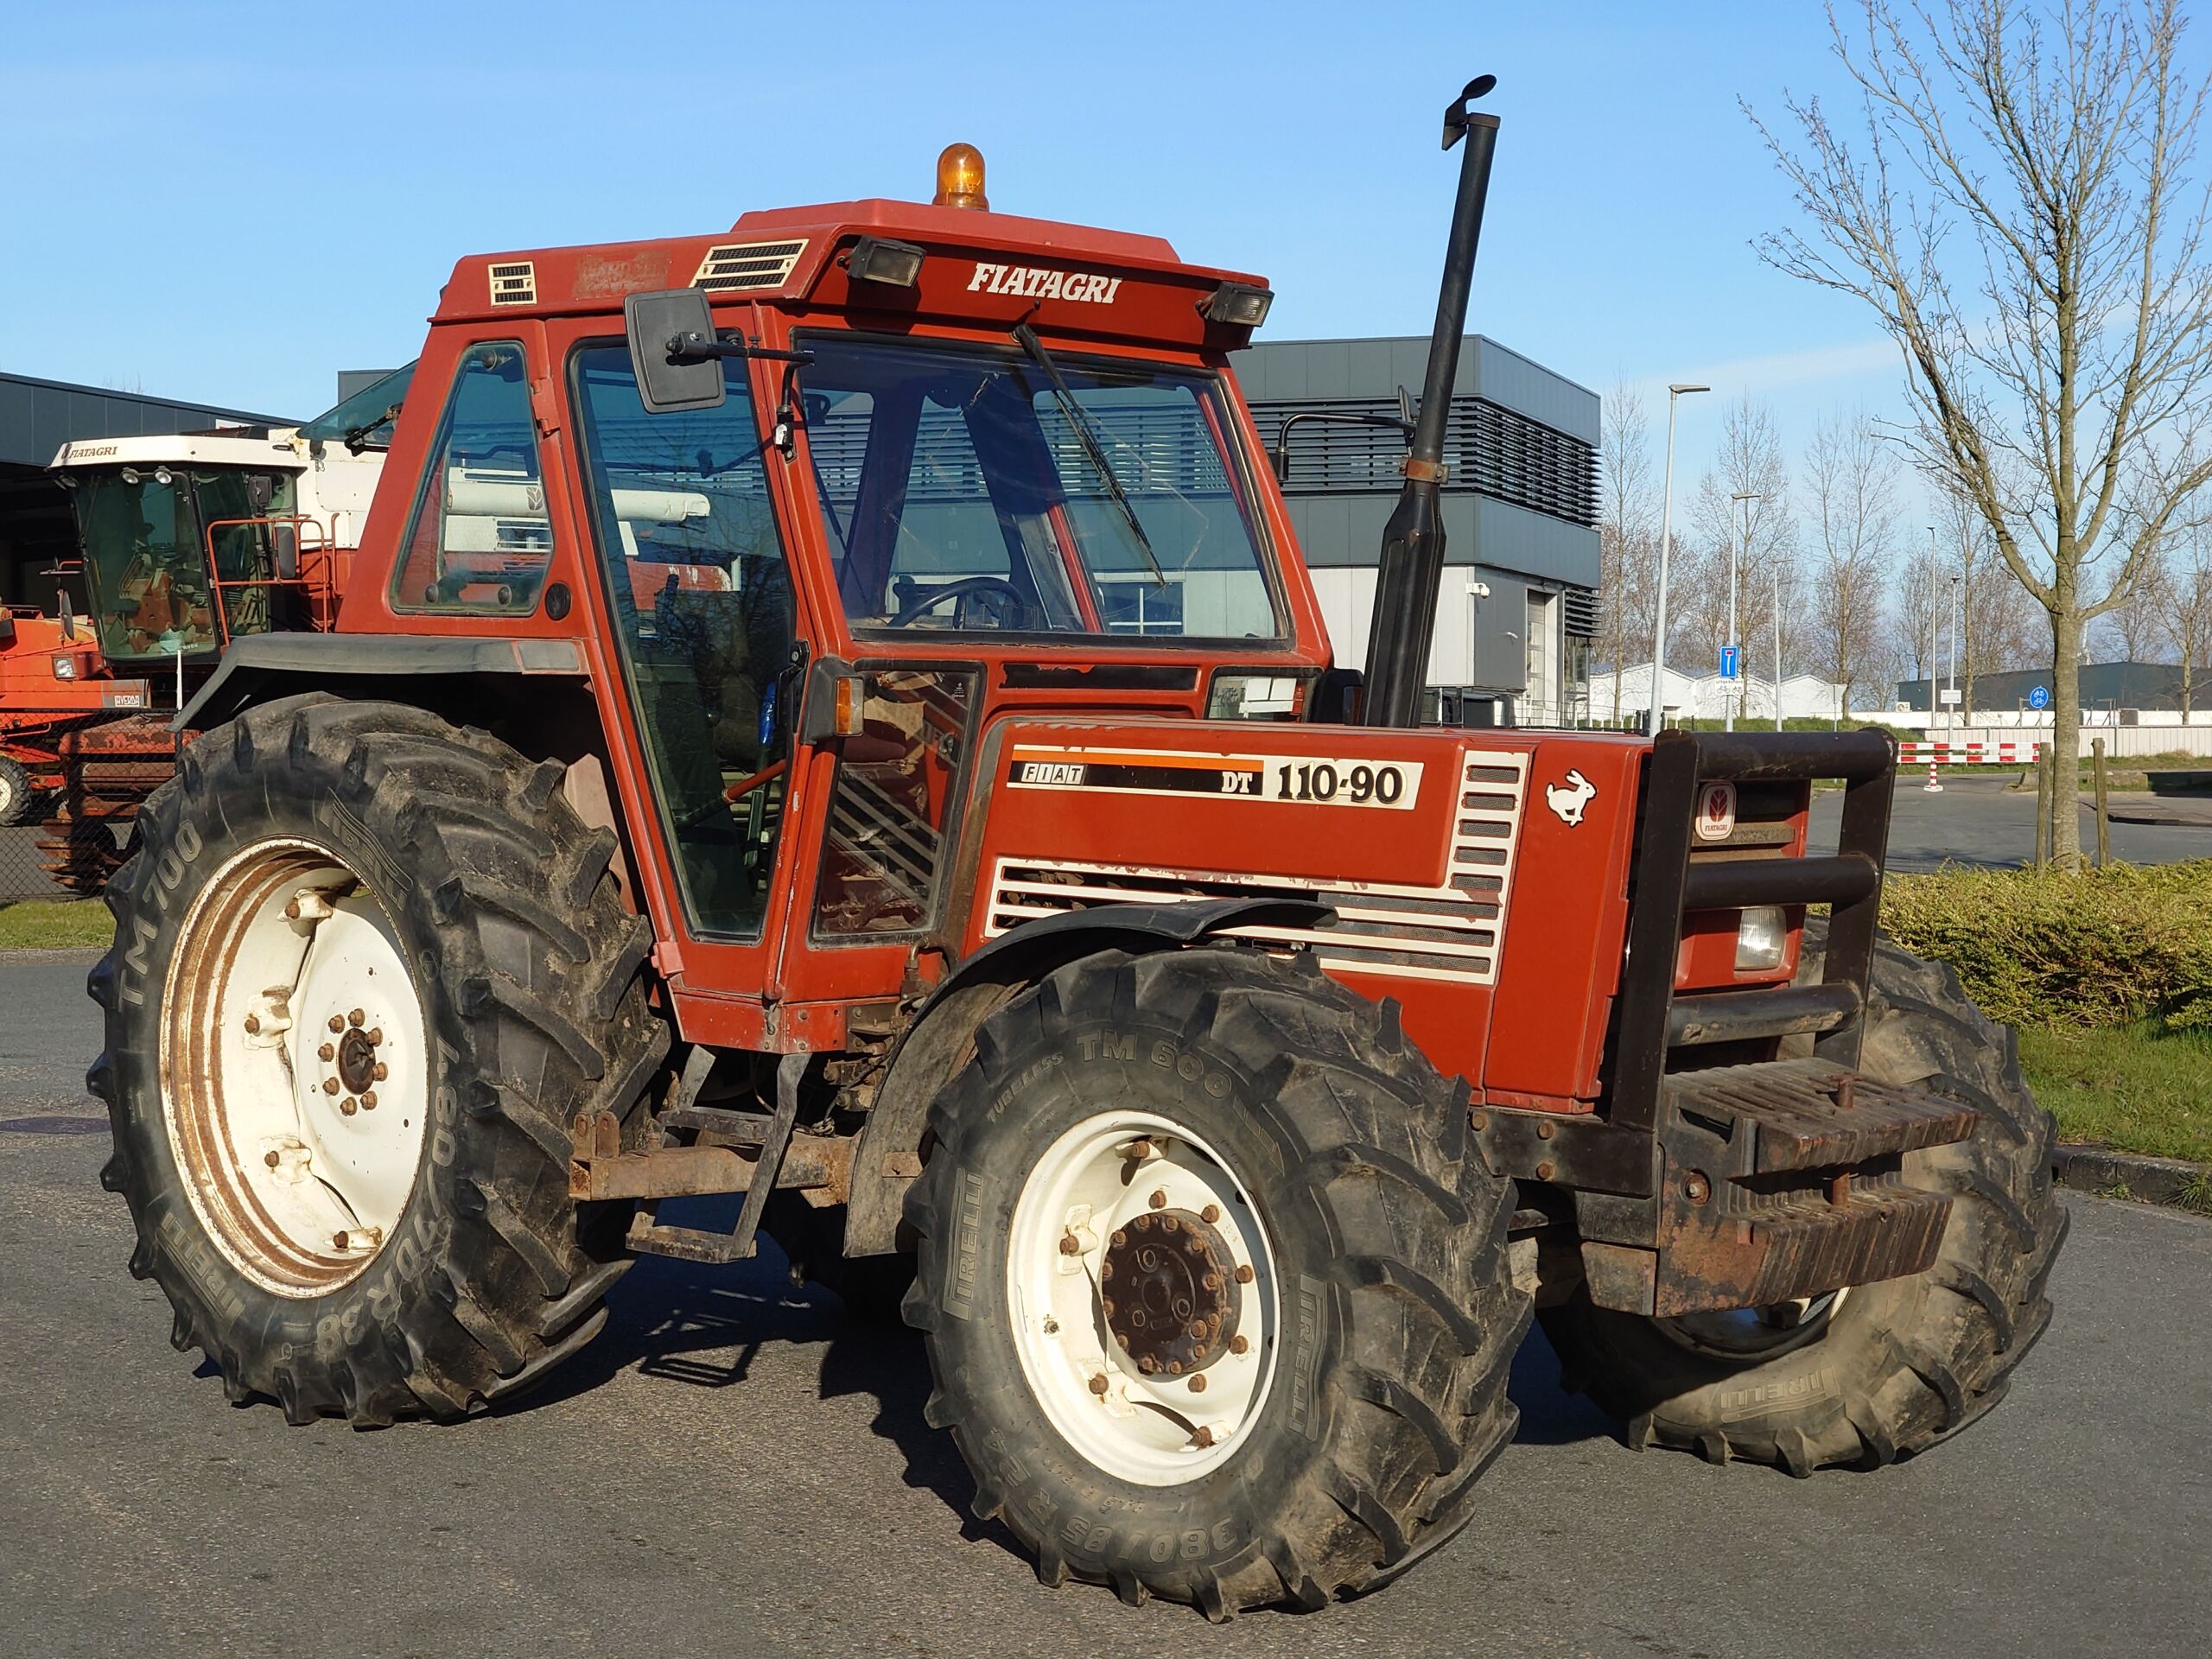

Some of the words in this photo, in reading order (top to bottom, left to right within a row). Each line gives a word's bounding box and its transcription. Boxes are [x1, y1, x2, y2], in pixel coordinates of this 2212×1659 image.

[967, 263, 1122, 304] FIATAGRI
[69, 446, 118, 459] FIATAGRI
[1021, 763, 1085, 785] FIAT
[1222, 772, 1253, 794] DT
[1278, 761, 1406, 804] 110-90
[118, 914, 158, 1013] TM
[142, 819, 203, 912] 700
[986, 1051, 1065, 1123] TUBELESS
[1076, 1030, 1139, 1062] TM
[1150, 1039, 1232, 1099] 600
[943, 1166, 983, 1322] PIRELLI
[1287, 1272, 1329, 1441] PIRELLI
[1720, 1365, 1841, 1424] PIRELLI
